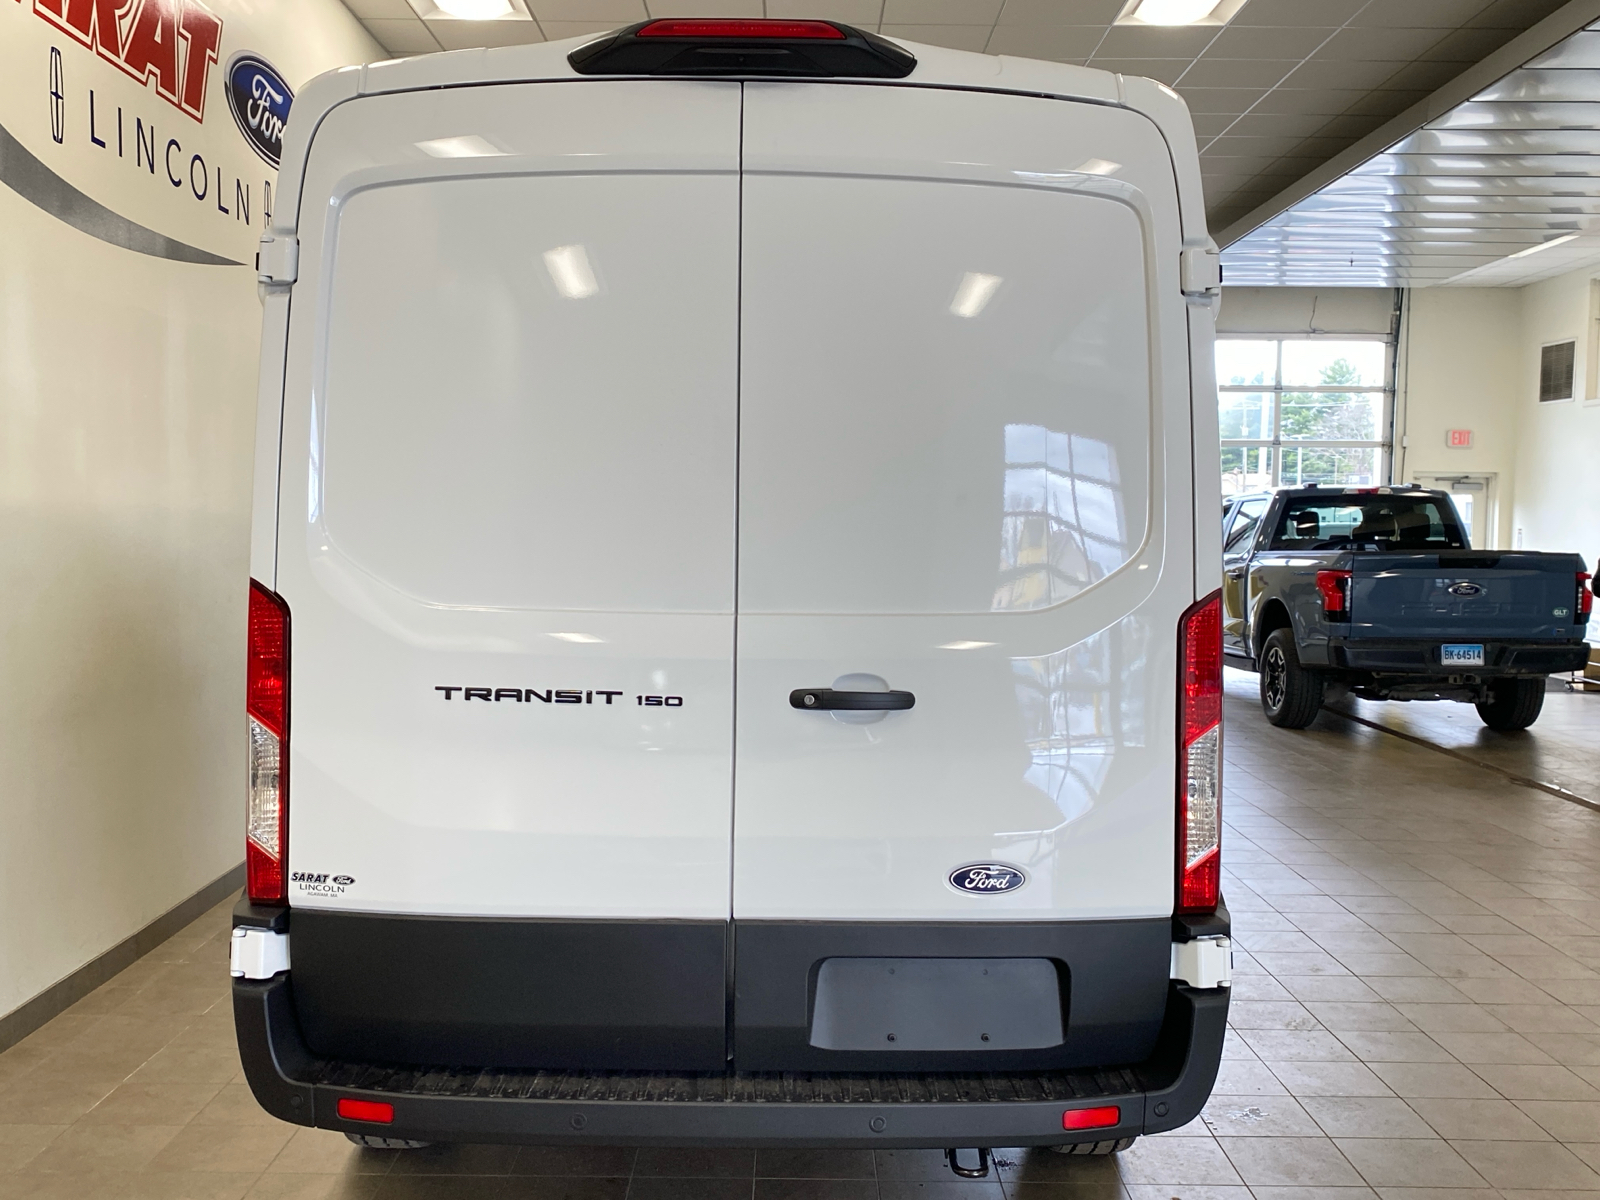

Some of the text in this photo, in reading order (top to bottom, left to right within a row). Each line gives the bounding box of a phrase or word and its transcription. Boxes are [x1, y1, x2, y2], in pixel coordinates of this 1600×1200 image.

[14, 0, 223, 124] RAT
[247, 74, 287, 143] For
[90, 89, 249, 226] LINCOLN
[1451, 430, 1471, 446] EXIT
[435, 686, 683, 706] TRANSIT 150
[291, 872, 329, 884] SARAT
[965, 869, 1010, 888] Ford
[299, 883, 345, 893] LINCOLN
